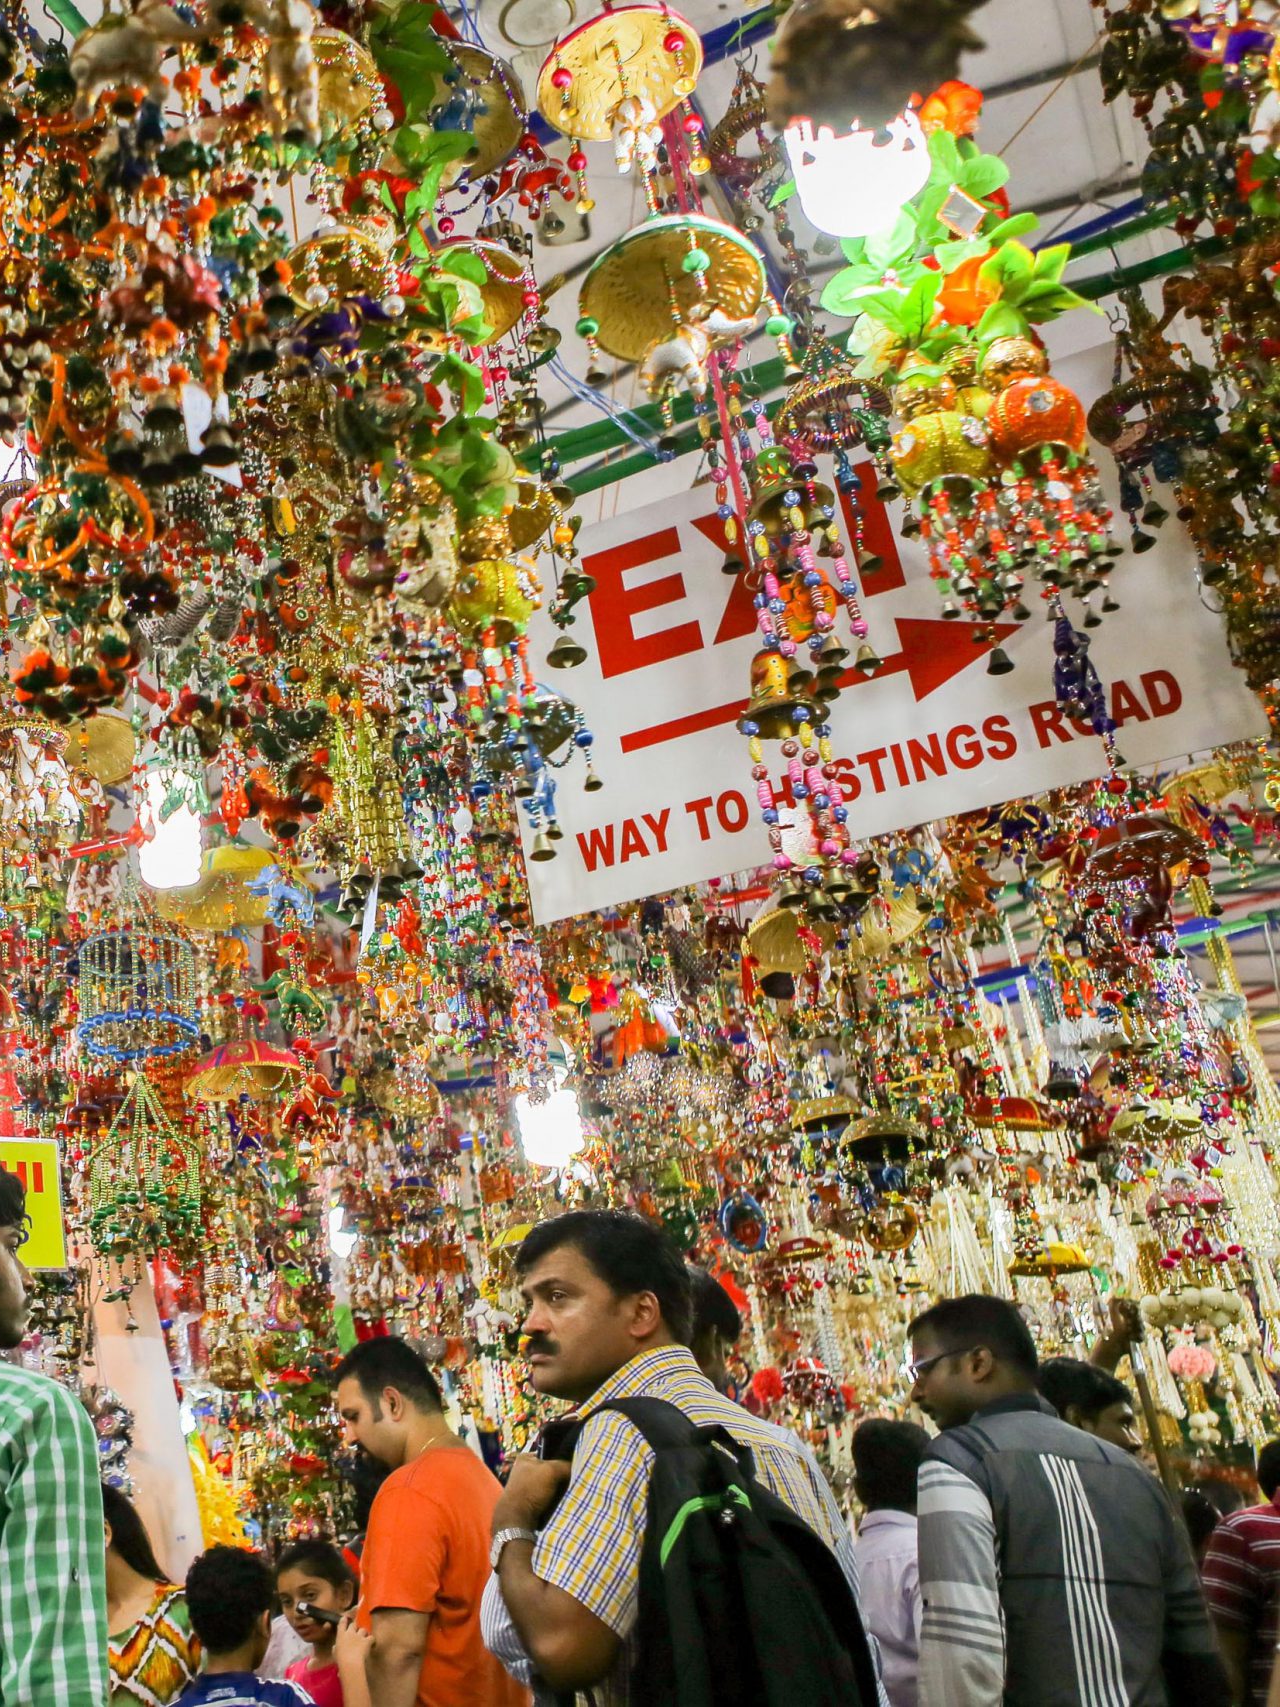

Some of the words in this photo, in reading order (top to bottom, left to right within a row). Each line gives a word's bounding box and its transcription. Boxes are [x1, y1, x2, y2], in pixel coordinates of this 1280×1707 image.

[581, 462, 907, 679] EXI
[576, 807, 671, 872] WAY
[684, 789, 749, 841] TO
